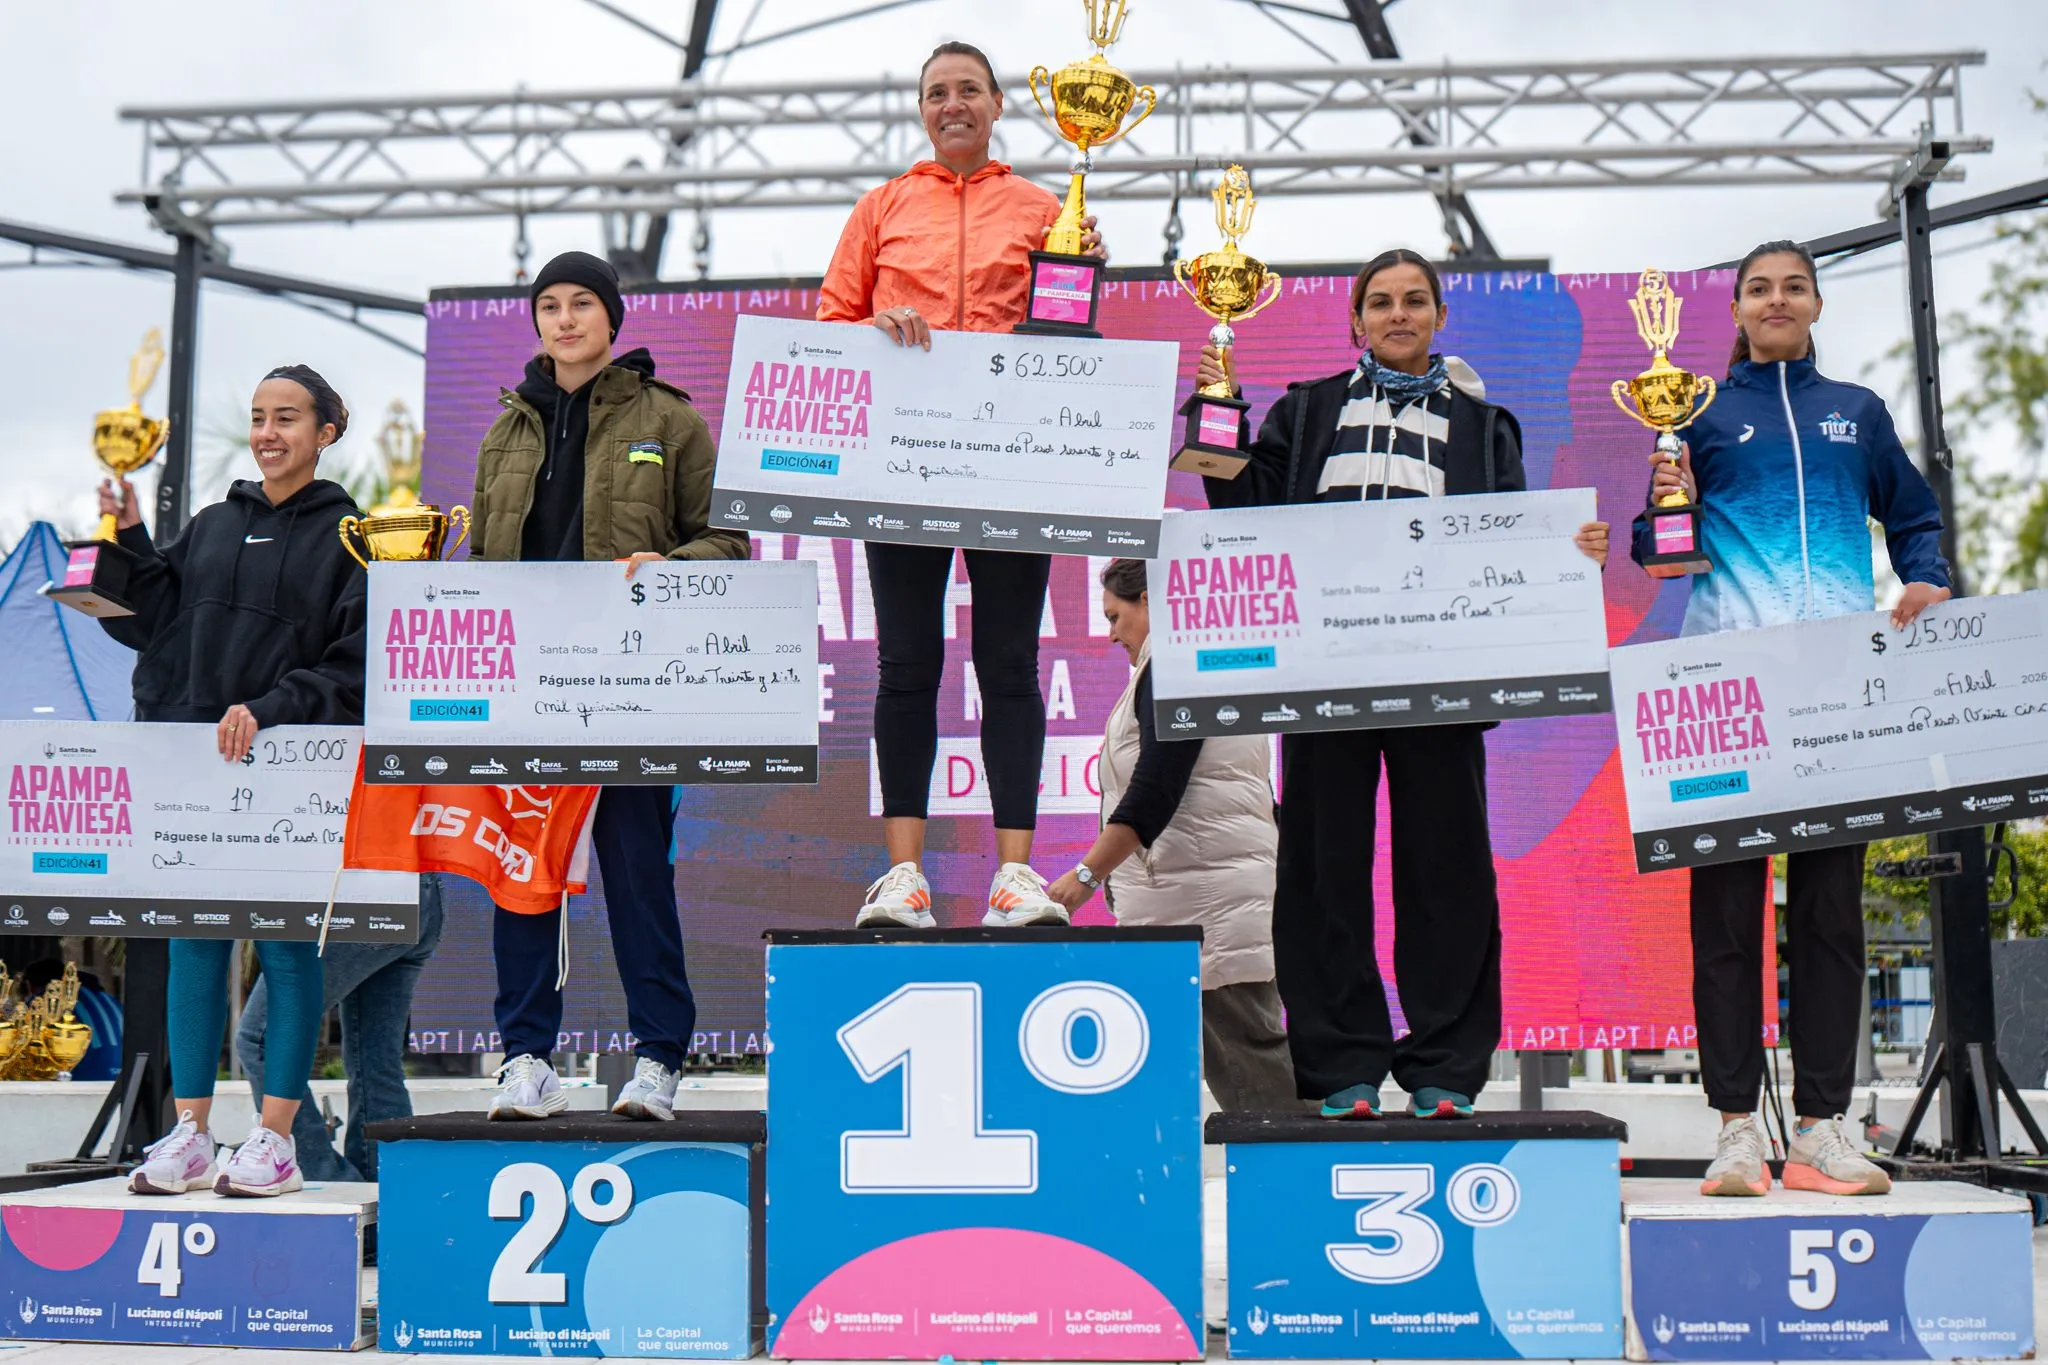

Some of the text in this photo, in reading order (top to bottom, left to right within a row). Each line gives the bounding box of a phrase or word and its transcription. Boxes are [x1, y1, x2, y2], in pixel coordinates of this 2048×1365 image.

[990, 354, 1005, 376] $
[745, 361, 872, 405] APAMPA
[744, 397, 868, 438] TRAVIESA
[894, 402, 1155, 431] Santa Rosa 19 de 2026
[738, 432, 867, 450] INTERNACIONAL
[891, 436, 1022, 454] Páguese la suma de
[767, 454, 832, 470] EDICIÓN41
[724, 513, 749, 521] CHALTEN
[813, 519, 846, 527] GONZALO
[1066, 530, 1092, 538] PAMPA
[1409, 518, 1424, 542] $
[1119, 537, 1145, 546] Pampa
[1167, 553, 1297, 597] APAMPA
[1321, 572, 1585, 597] Santa Rosa 2026
[631, 582, 645, 605] $
[1167, 592, 1300, 631] TRAVIESA
[385, 608, 516, 645] APAMPA
[1323, 610, 1456, 630] Páguese la suma de
[539, 630, 802, 654] Santa Rosa 19 de 2026
[1871, 632, 1887, 655] $
[385, 646, 516, 680] TRAVIESA
[1683, 664, 1703, 672] Santa
[384, 684, 516, 692] INTERNACIONAL
[539, 675, 671, 688] Páguese la suma de
[1636, 676, 1765, 729] APAMPA
[1788, 673, 2047, 718] Santa Rosa 19 de 2026
[417, 703, 482, 716] EDICIÓN41
[1636, 714, 1769, 764] TRAVIESA
[1793, 721, 1924, 748] Páguese la suma de
[241, 746, 255, 767] $
[1640, 751, 1772, 777] INTERNACIONAL
[777, 765, 803, 773] Pampa
[9, 765, 132, 802] APAMPA
[1676, 775, 1741, 796] EDICIÓN41
[154, 787, 306, 814] Santa Rosa 19 de
[8, 801, 132, 835] TRAVIESA
[7, 837, 133, 848] INTERNACIONAL
[154, 831, 280, 846] Páguese la suma de
[39, 856, 101, 869] EDICIÓN41
[408, 1032, 449, 1052] APT
[1522, 1025, 1640, 1048] APT APT
[42, 1304, 102, 1316] Santa Rosa
[127, 1307, 223, 1321] Luciano di Nápoli
[248, 1308, 308, 1321] La Capital
[1065, 1309, 1132, 1323] La Capital
[1507, 1309, 1574, 1322] La Capital
[46, 1317, 95, 1325] MUNICIPIO
[145, 1320, 202, 1328] INTENDENTE
[834, 1312, 903, 1324] Santa Rosa
[930, 1311, 1038, 1326] Luciano di Nápoli
[1273, 1313, 1343, 1325] Santa Rosa
[1370, 1311, 1479, 1326] Luciano di Nápoli
[1918, 1316, 1986, 1331] La Capital
[247, 1322, 333, 1333] que queremos
[417, 1328, 482, 1339] Santa Rosa
[637, 1327, 701, 1340] La Capital
[1065, 1323, 1161, 1335] que queremos
[1508, 1322, 1604, 1335] que queremos
[1679, 1321, 1749, 1333] Santa Rosa
[1778, 1319, 1889, 1334] Luciano di Nápoli
[508, 1328, 610, 1341] Luciano di Nápoli
[1919, 1330, 2016, 1342] que queremos
[528, 1341, 588, 1349] INTENDENTE
[638, 1340, 729, 1351] que queremos
